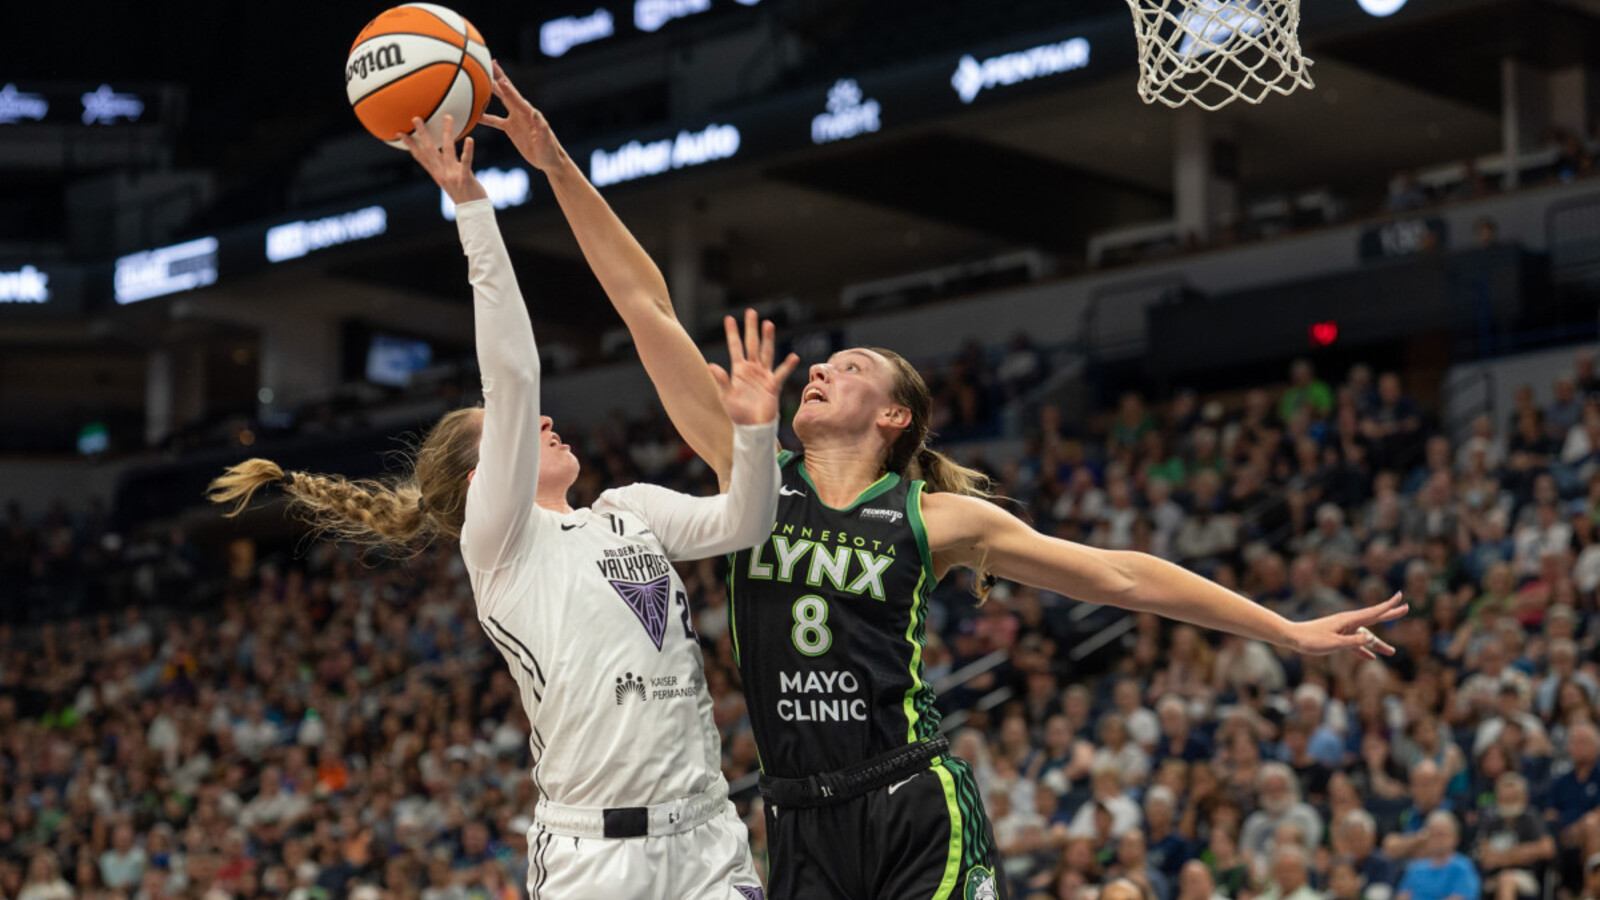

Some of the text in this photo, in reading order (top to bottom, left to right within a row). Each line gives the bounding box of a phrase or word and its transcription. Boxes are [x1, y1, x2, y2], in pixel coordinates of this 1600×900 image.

[345, 43, 405, 82] Wilso
[980, 37, 1091, 89] PENTAIR
[672, 124, 740, 169] Auto
[772, 521, 896, 556] INNESOTA
[596, 553, 670, 582] VALKYRIES
[748, 534, 895, 601] LYNX
[792, 594, 833, 657] 8
[651, 676, 678, 687] KAISER
[779, 670, 859, 694] MAYO
[777, 699, 868, 722] CLINIC
